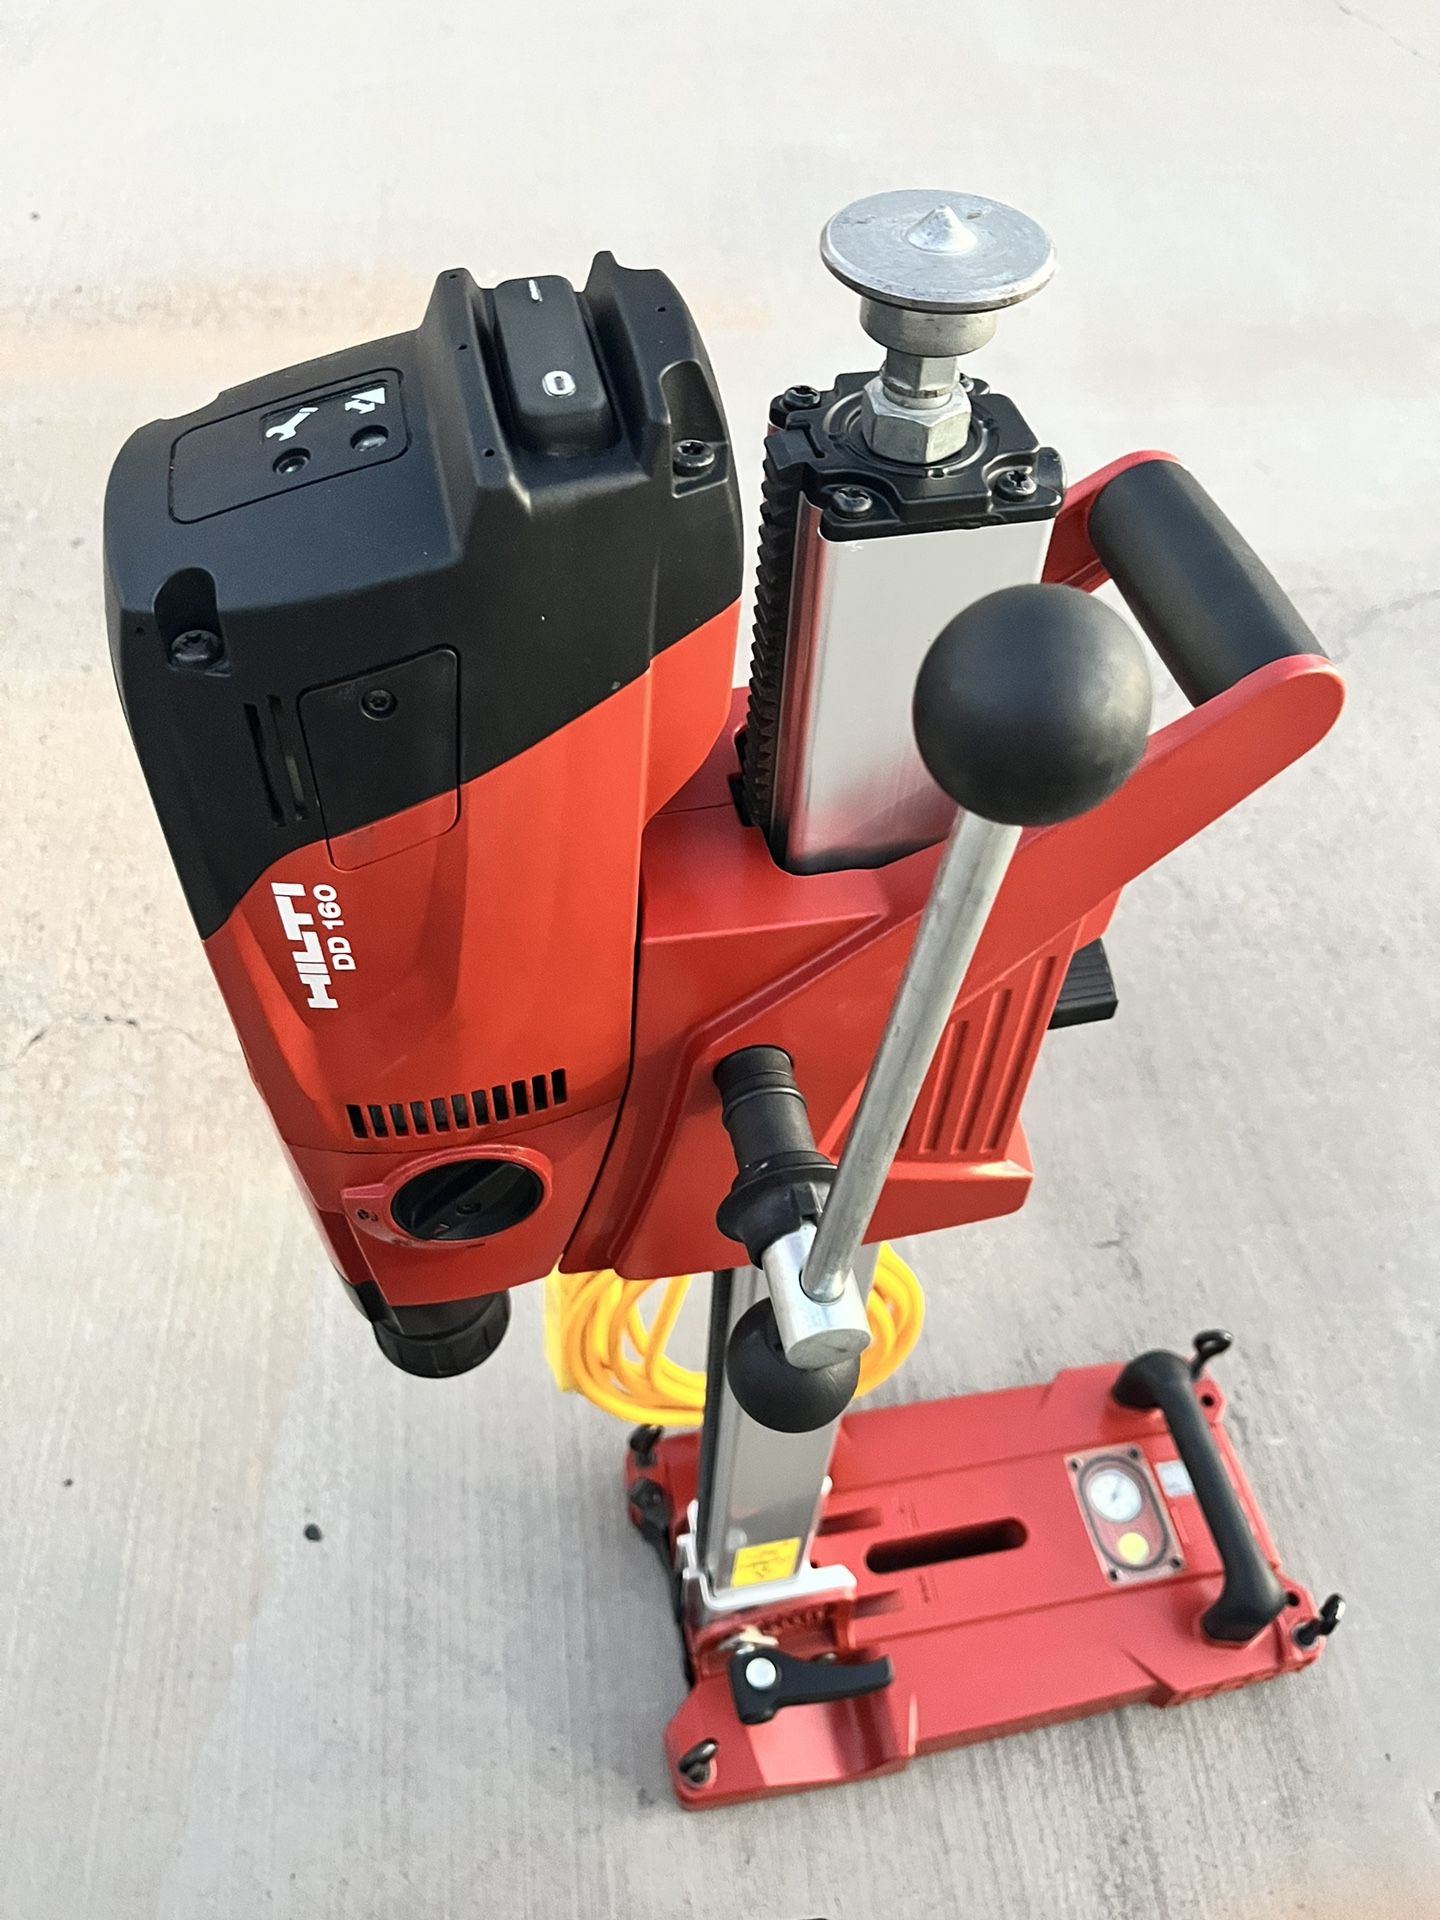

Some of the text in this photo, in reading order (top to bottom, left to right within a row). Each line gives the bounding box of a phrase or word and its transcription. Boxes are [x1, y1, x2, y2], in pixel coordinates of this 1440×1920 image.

[271, 883, 339, 1008] HILTI
[313, 884, 357, 970] DD 160
